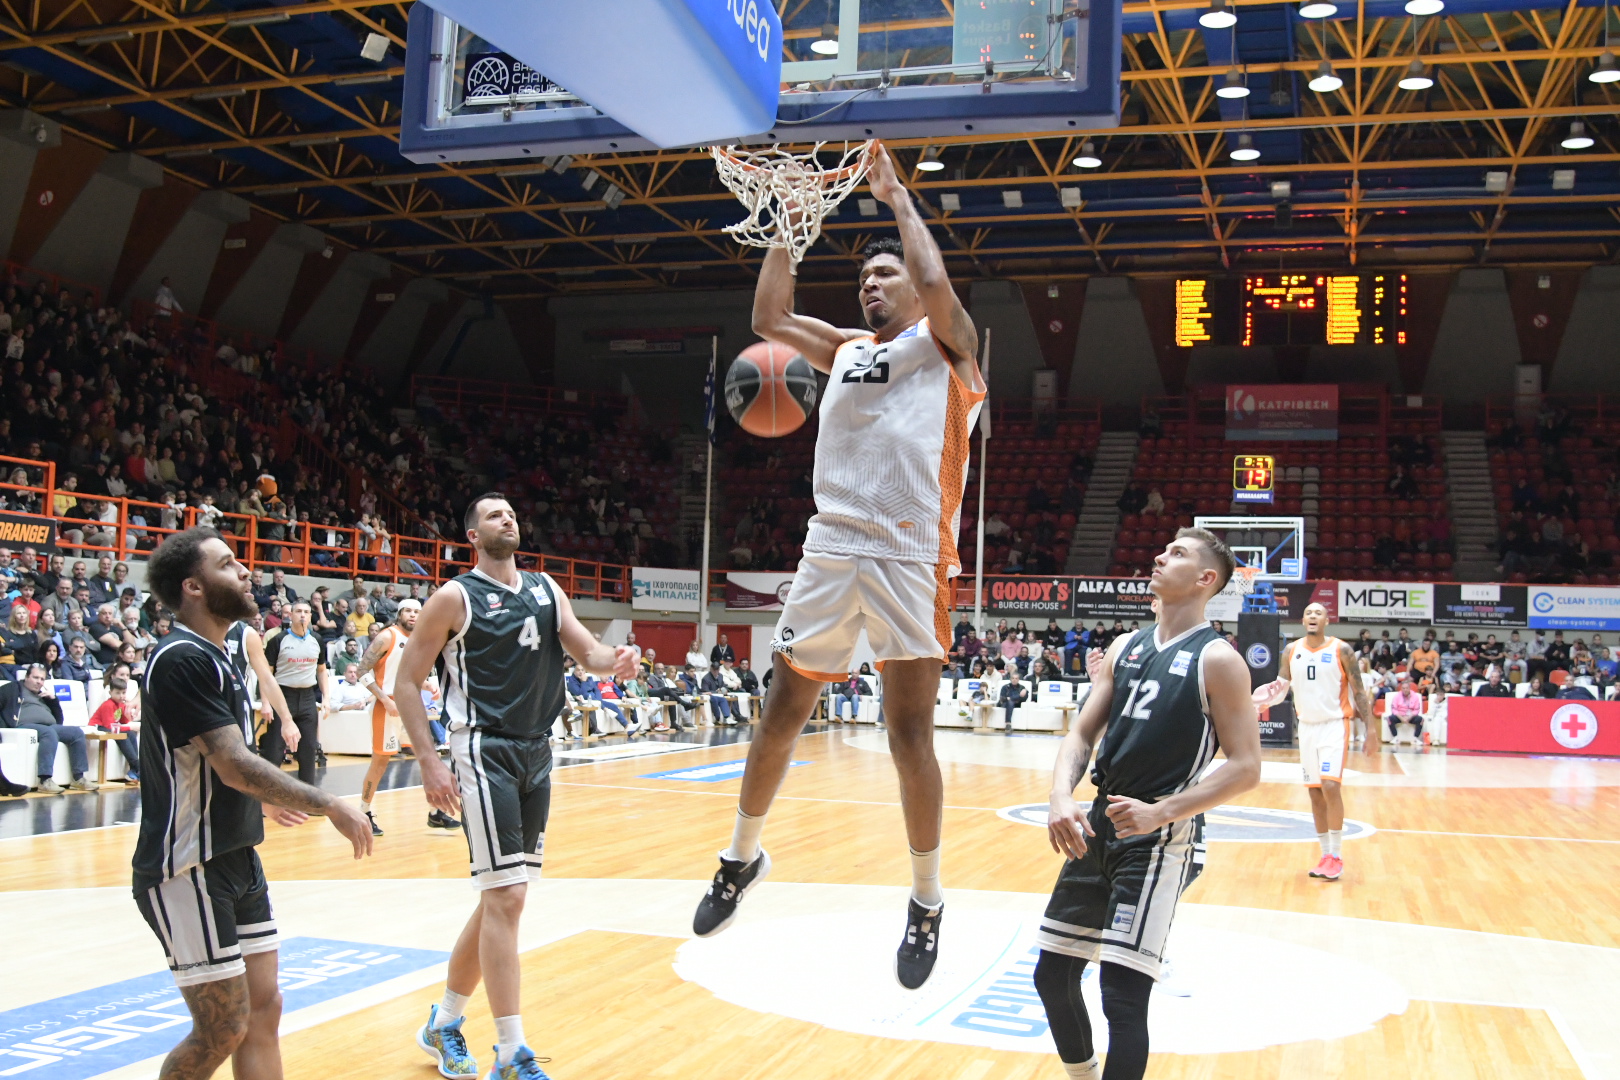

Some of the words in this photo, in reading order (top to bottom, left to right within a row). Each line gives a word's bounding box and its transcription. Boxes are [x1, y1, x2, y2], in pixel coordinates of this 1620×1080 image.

[1077, 580, 1115, 594] ALFA
[652, 589, 699, 601] ΜΠΑΛΗΣ
[1557, 597, 1585, 605] CLEAN
[998, 601, 1029, 610] BURGER
[1031, 602, 1059, 611] HOUSE
[517, 615, 542, 652] 4
[1306, 665, 1316, 681] 0
[1121, 679, 1161, 721] 12
